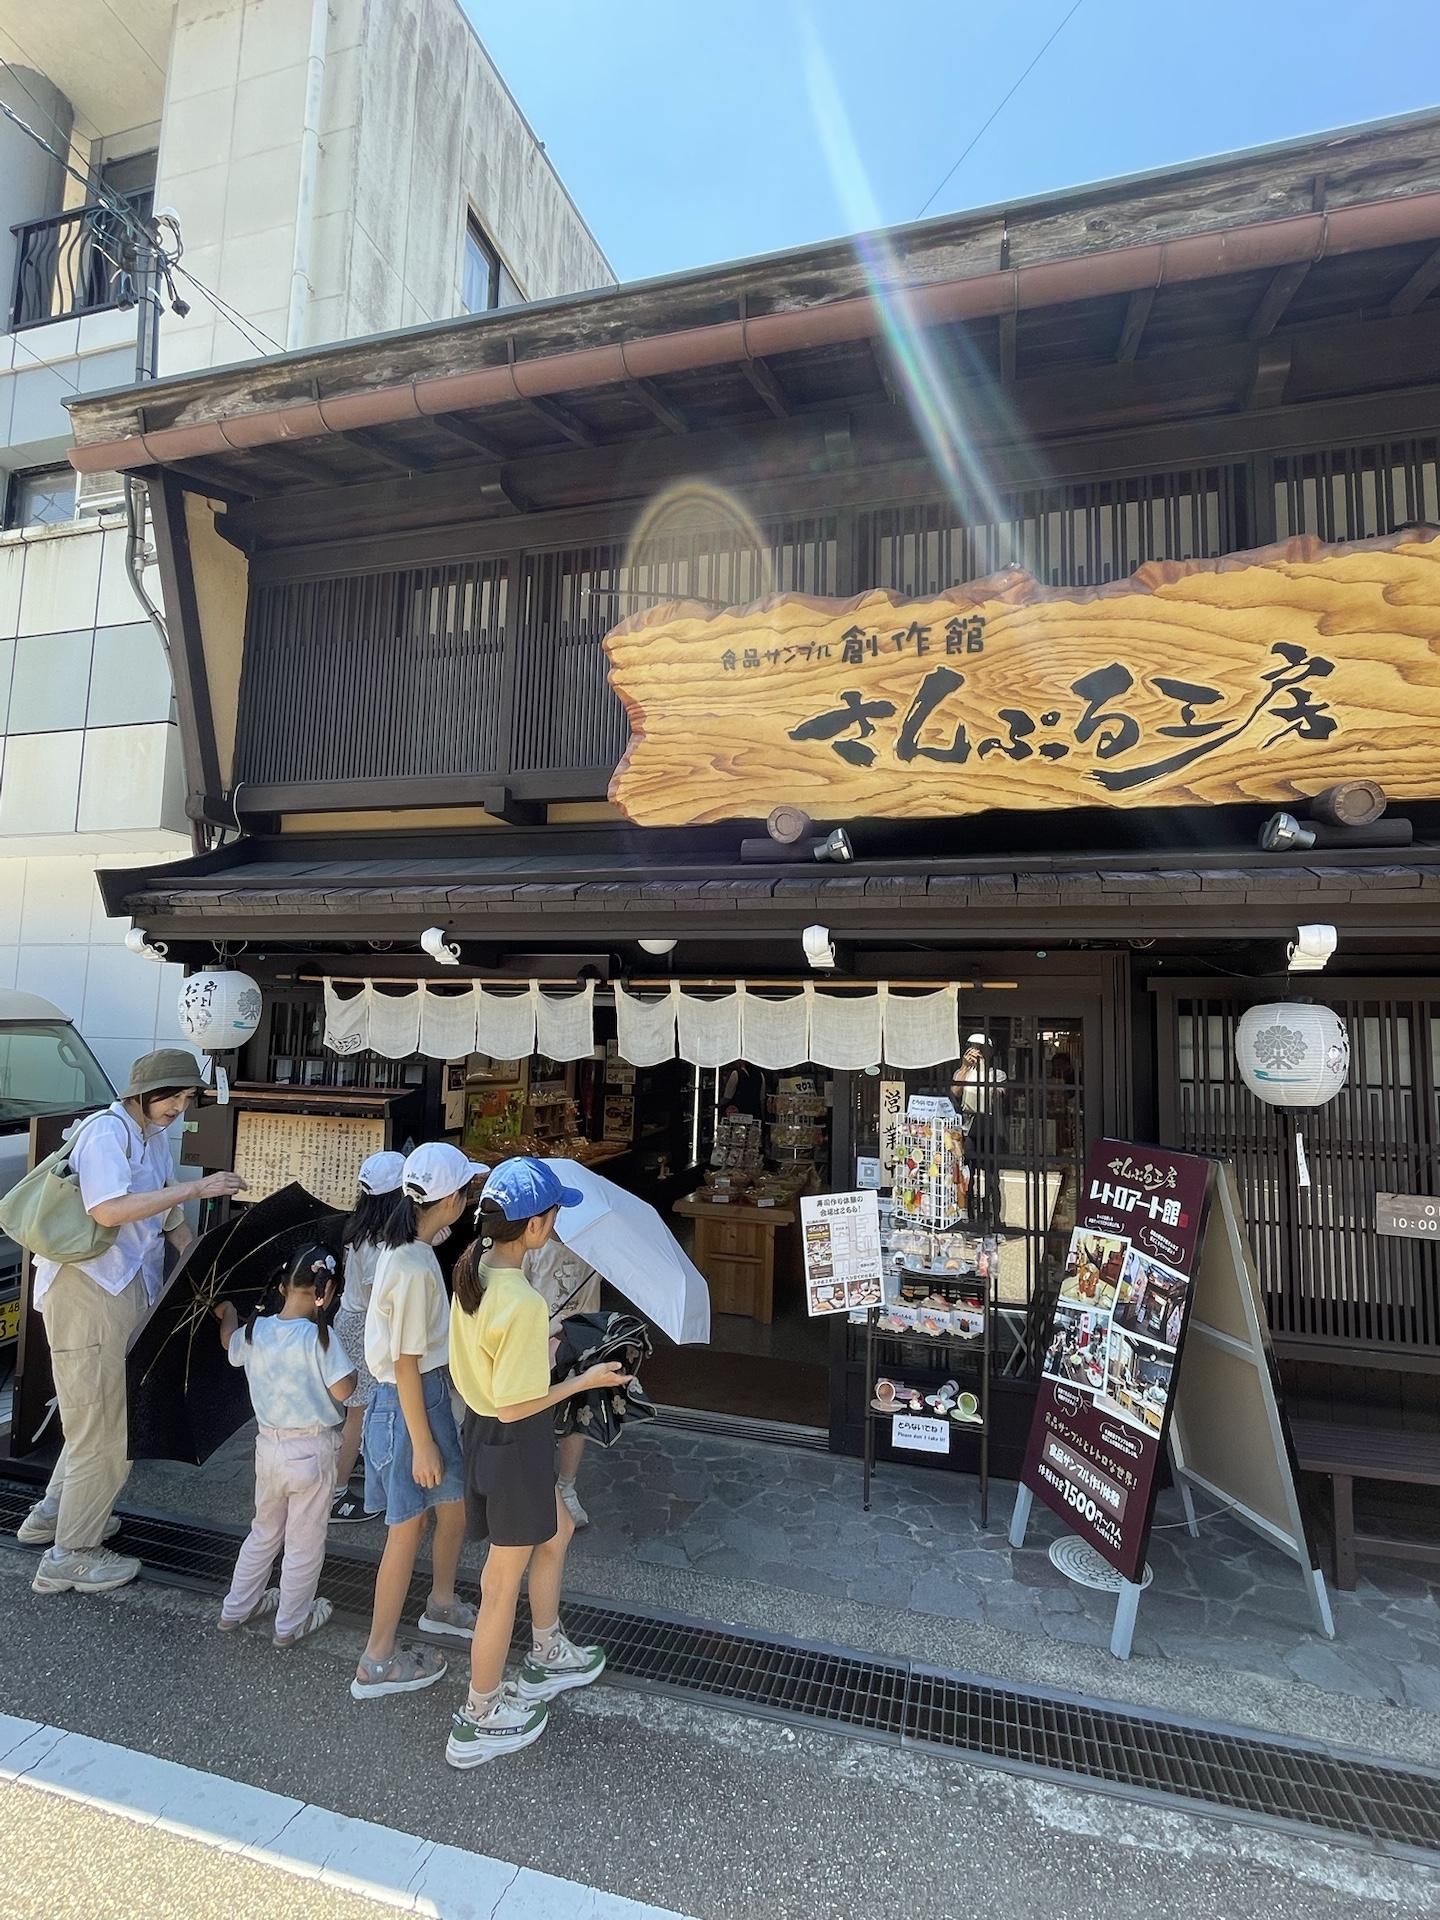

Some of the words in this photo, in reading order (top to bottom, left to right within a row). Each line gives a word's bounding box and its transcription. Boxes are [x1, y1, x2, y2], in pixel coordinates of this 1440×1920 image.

[788, 642, 1339, 791] さんぷる工房
[1107, 1156, 1178, 1191] さんぷる工房
[1089, 1179, 1181, 1227] レトロアート館
[1425, 1205, 1440, 1217] O
